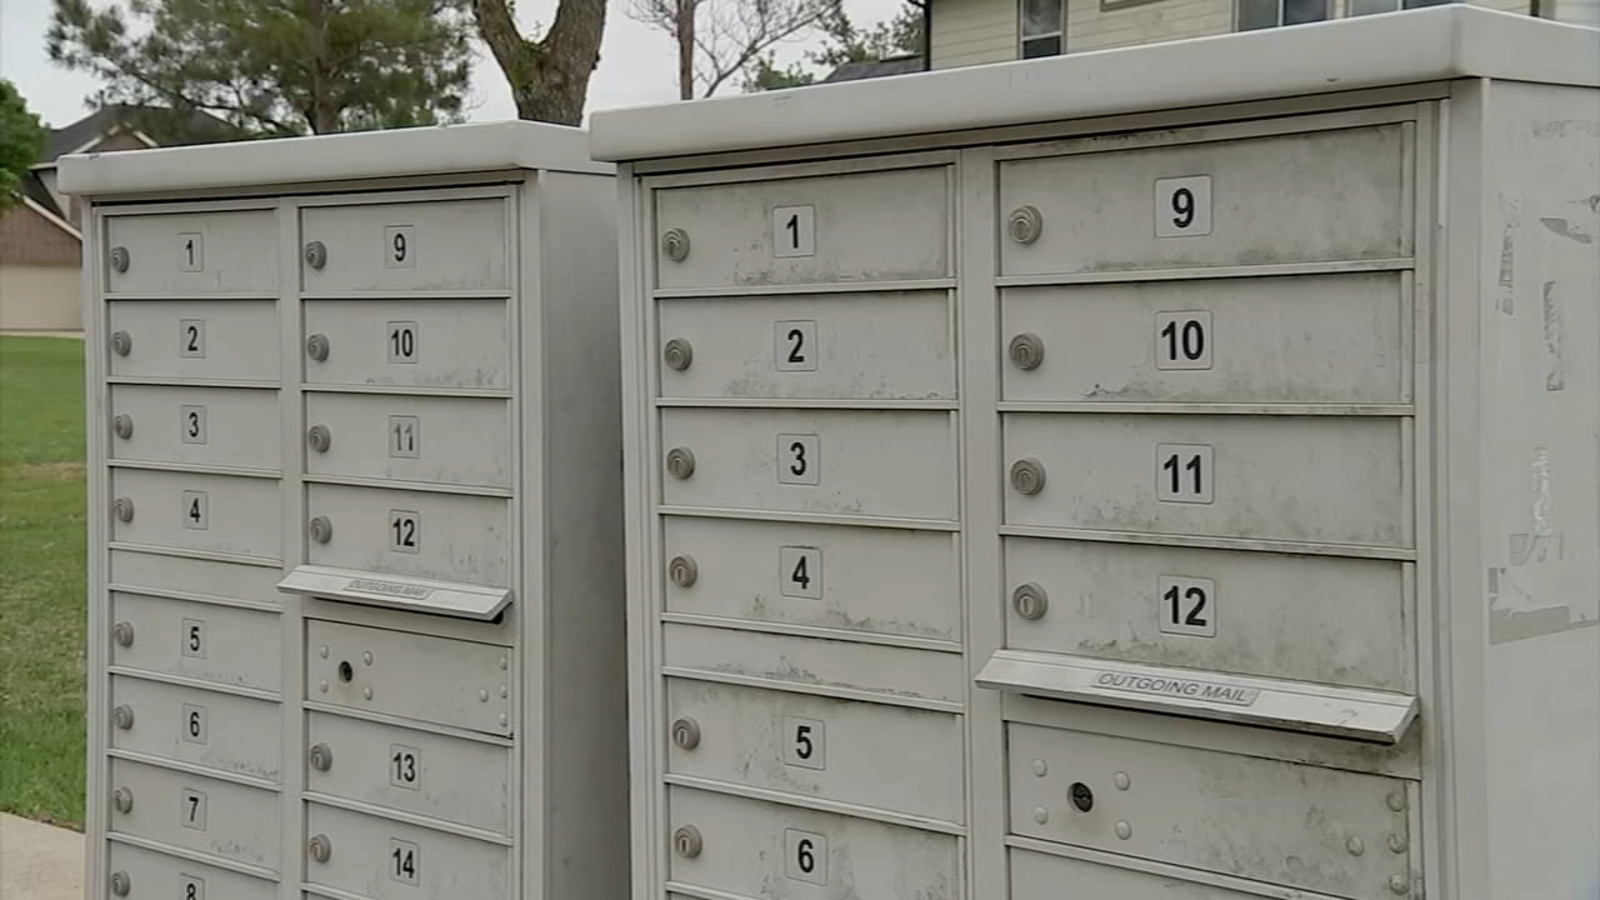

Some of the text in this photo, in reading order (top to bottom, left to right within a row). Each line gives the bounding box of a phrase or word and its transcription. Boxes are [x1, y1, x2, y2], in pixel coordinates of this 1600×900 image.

[1172, 187, 1194, 229] 9
[394, 232, 406, 262] 9
[787, 214, 799, 249] 1
[185, 238, 194, 265] 1
[187, 324, 199, 352] 2
[391, 328, 413, 358] 10
[788, 329, 805, 363] 2
[1162, 320, 1204, 361] 10
[188, 410, 200, 438] 3
[393, 423, 414, 453] 11
[790, 442, 806, 476] 3
[1163, 454, 1201, 494] 11
[189, 496, 202, 524] 4
[392, 517, 416, 548] 12
[792, 556, 810, 590] 4
[1164, 584, 1207, 627] 12
[189, 624, 201, 653] 5
[1099, 673, 1247, 702] OUTGOING MAIL
[189, 709, 201, 738] 6
[796, 725, 813, 760] 5
[392, 751, 416, 783] 13
[188, 794, 200, 823] 7
[392, 847, 416, 880] 14
[798, 838, 815, 873] 6
